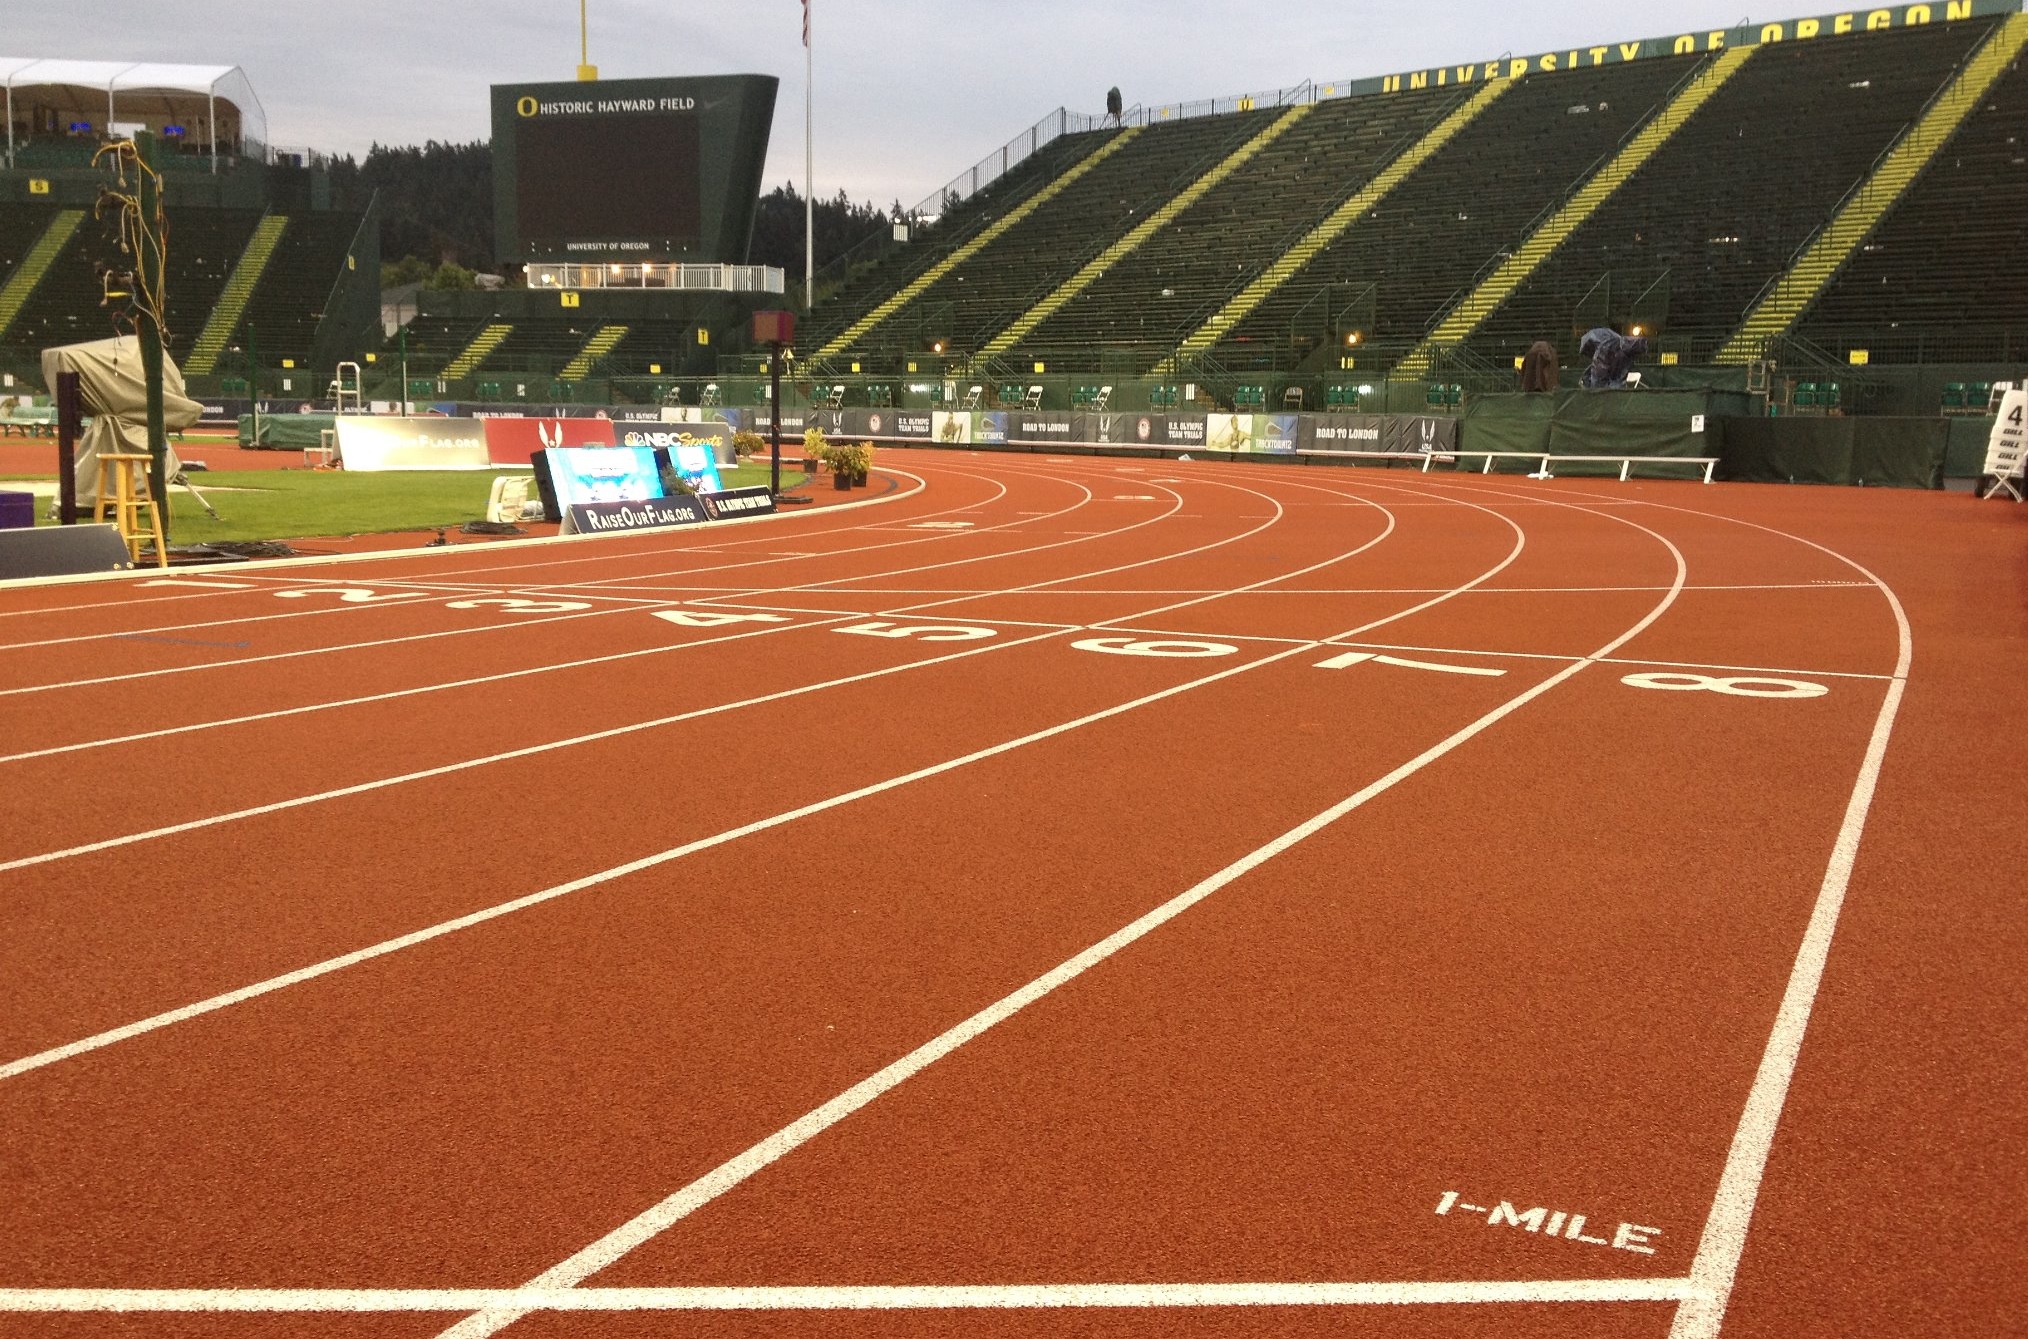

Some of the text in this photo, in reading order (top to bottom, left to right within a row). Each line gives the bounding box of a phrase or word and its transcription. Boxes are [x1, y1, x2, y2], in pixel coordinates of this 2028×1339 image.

[1760, 0, 1972, 44] OREGON
[516, 96, 538, 117] O
[540, 97, 695, 115] HISTORIC HAYWARD FIELD
[34, 181, 43, 192] S
[567, 242, 650, 251] UNIVERSITY OF OREGON
[755, 417, 803, 426] ROAD LONDON
[2007, 405, 2023, 426] 4
[1022, 423, 1070, 432] ROAD TO LONDON
[1168, 422, 1203, 431] U.S. OLYMPIC
[1316, 428, 1379, 440] ROAD TO LONDON
[643, 432, 723, 447] NBC Sports
[1168, 430, 1203, 439] TEAM TRIALS
[132, 579, 258, 589] 1
[272, 588, 430, 603] 2
[445, 599, 593, 613] 3
[650, 610, 794, 627] 4
[829, 621, 998, 641] 5
[1070, 637, 1239, 658] 6
[1620, 672, 1829, 698] 8
[1434, 1191, 1662, 1255] 1-MILE
